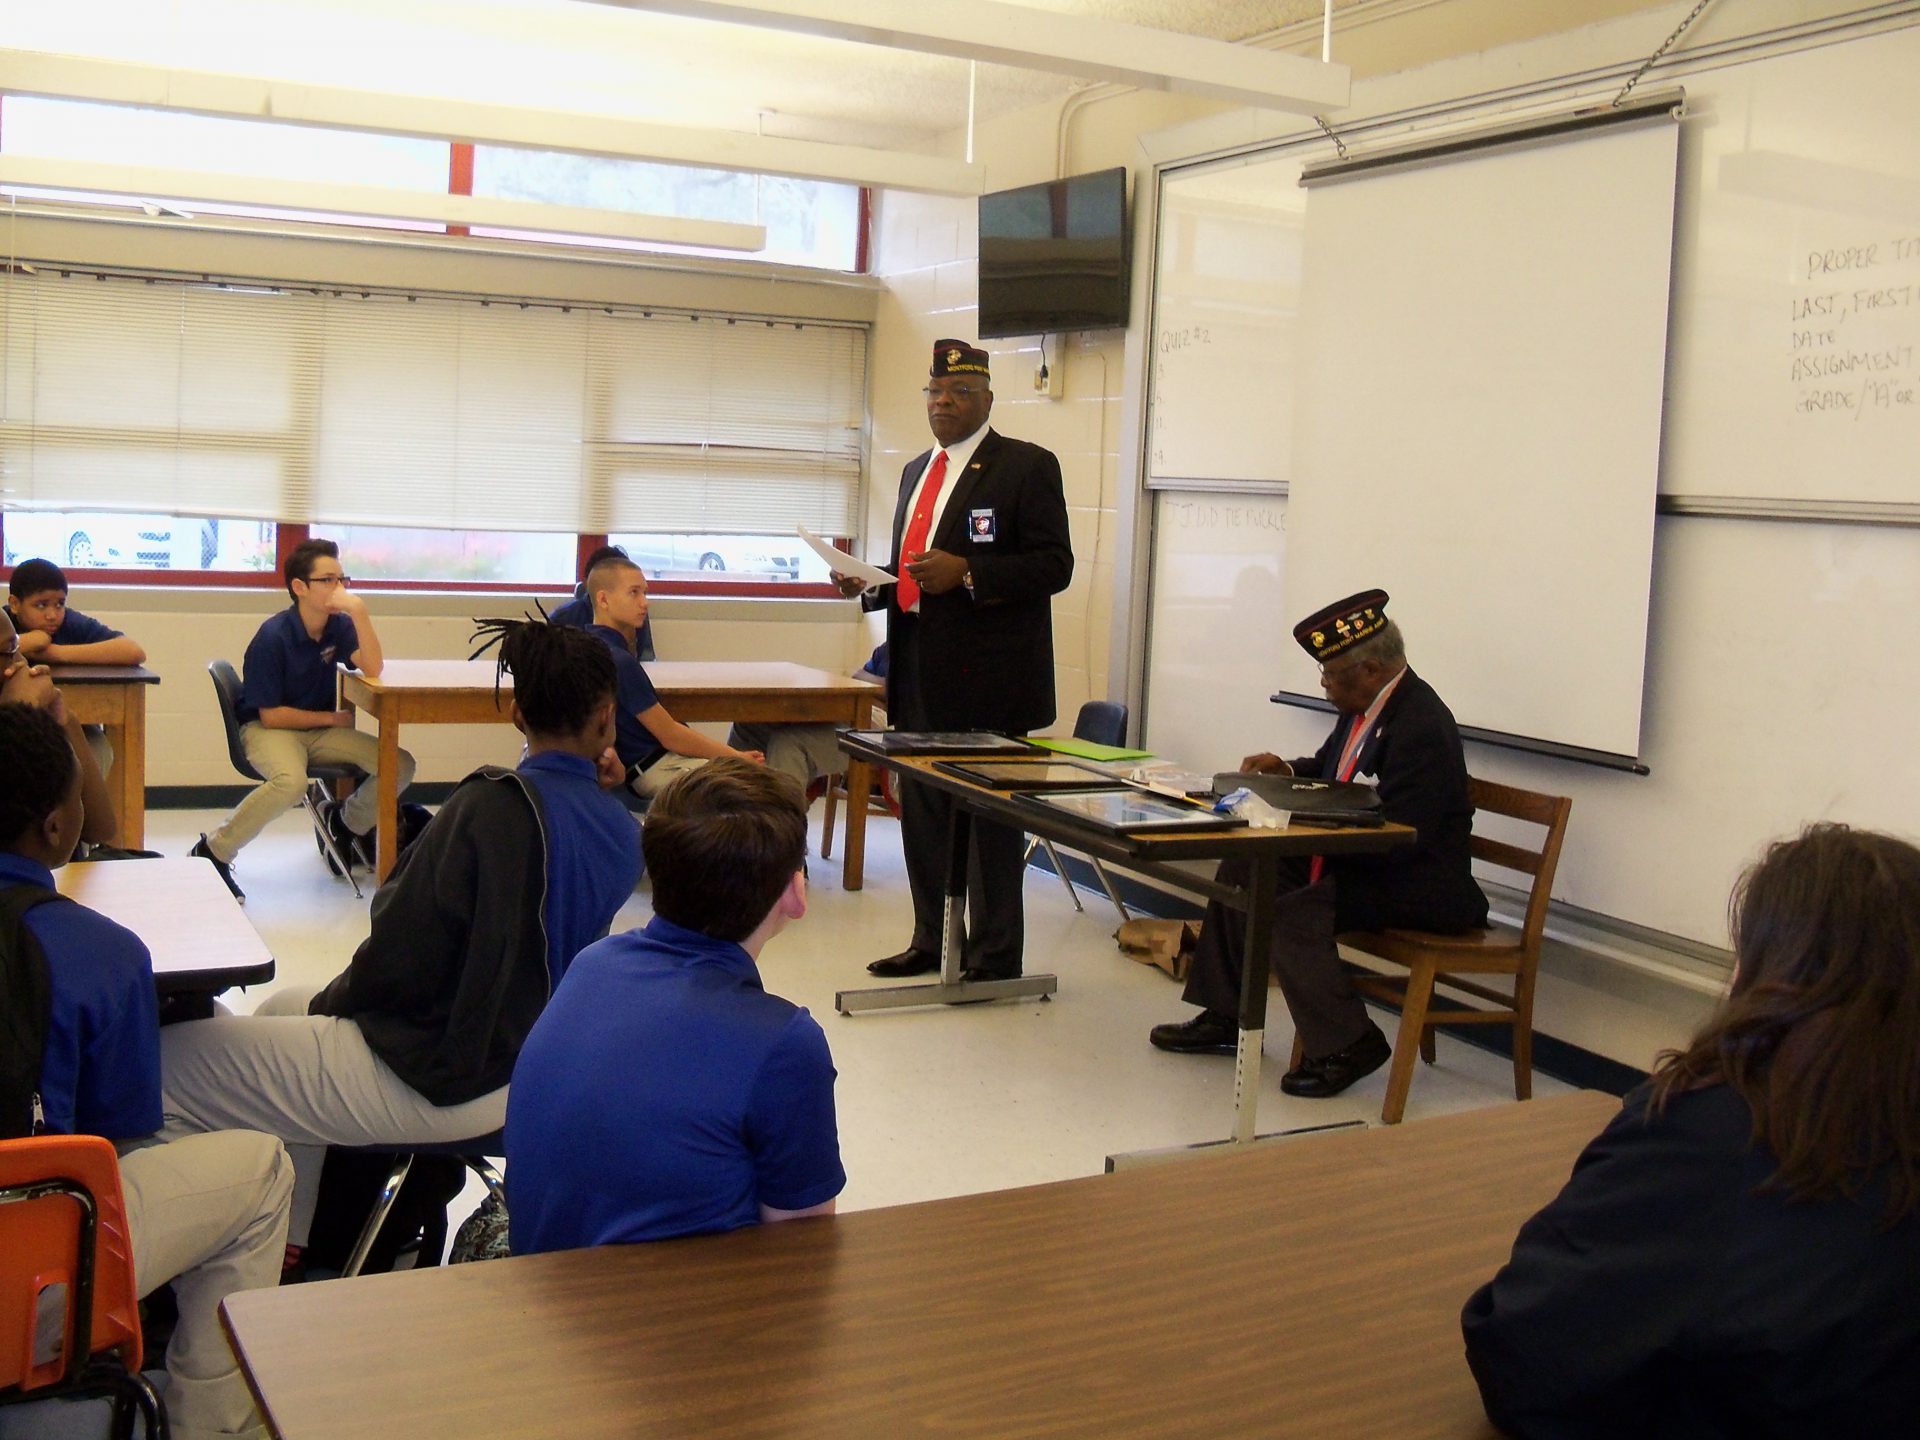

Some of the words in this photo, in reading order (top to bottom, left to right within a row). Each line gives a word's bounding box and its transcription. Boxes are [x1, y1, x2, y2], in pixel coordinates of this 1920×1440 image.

[1807, 243, 1879, 280] PROPER
[1852, 285, 1912, 313] FIRST
[1160, 329, 1191, 353] QUIZ
[1791, 329, 1836, 350] DATE
[1791, 346, 1913, 382] ASSIGNMENT
